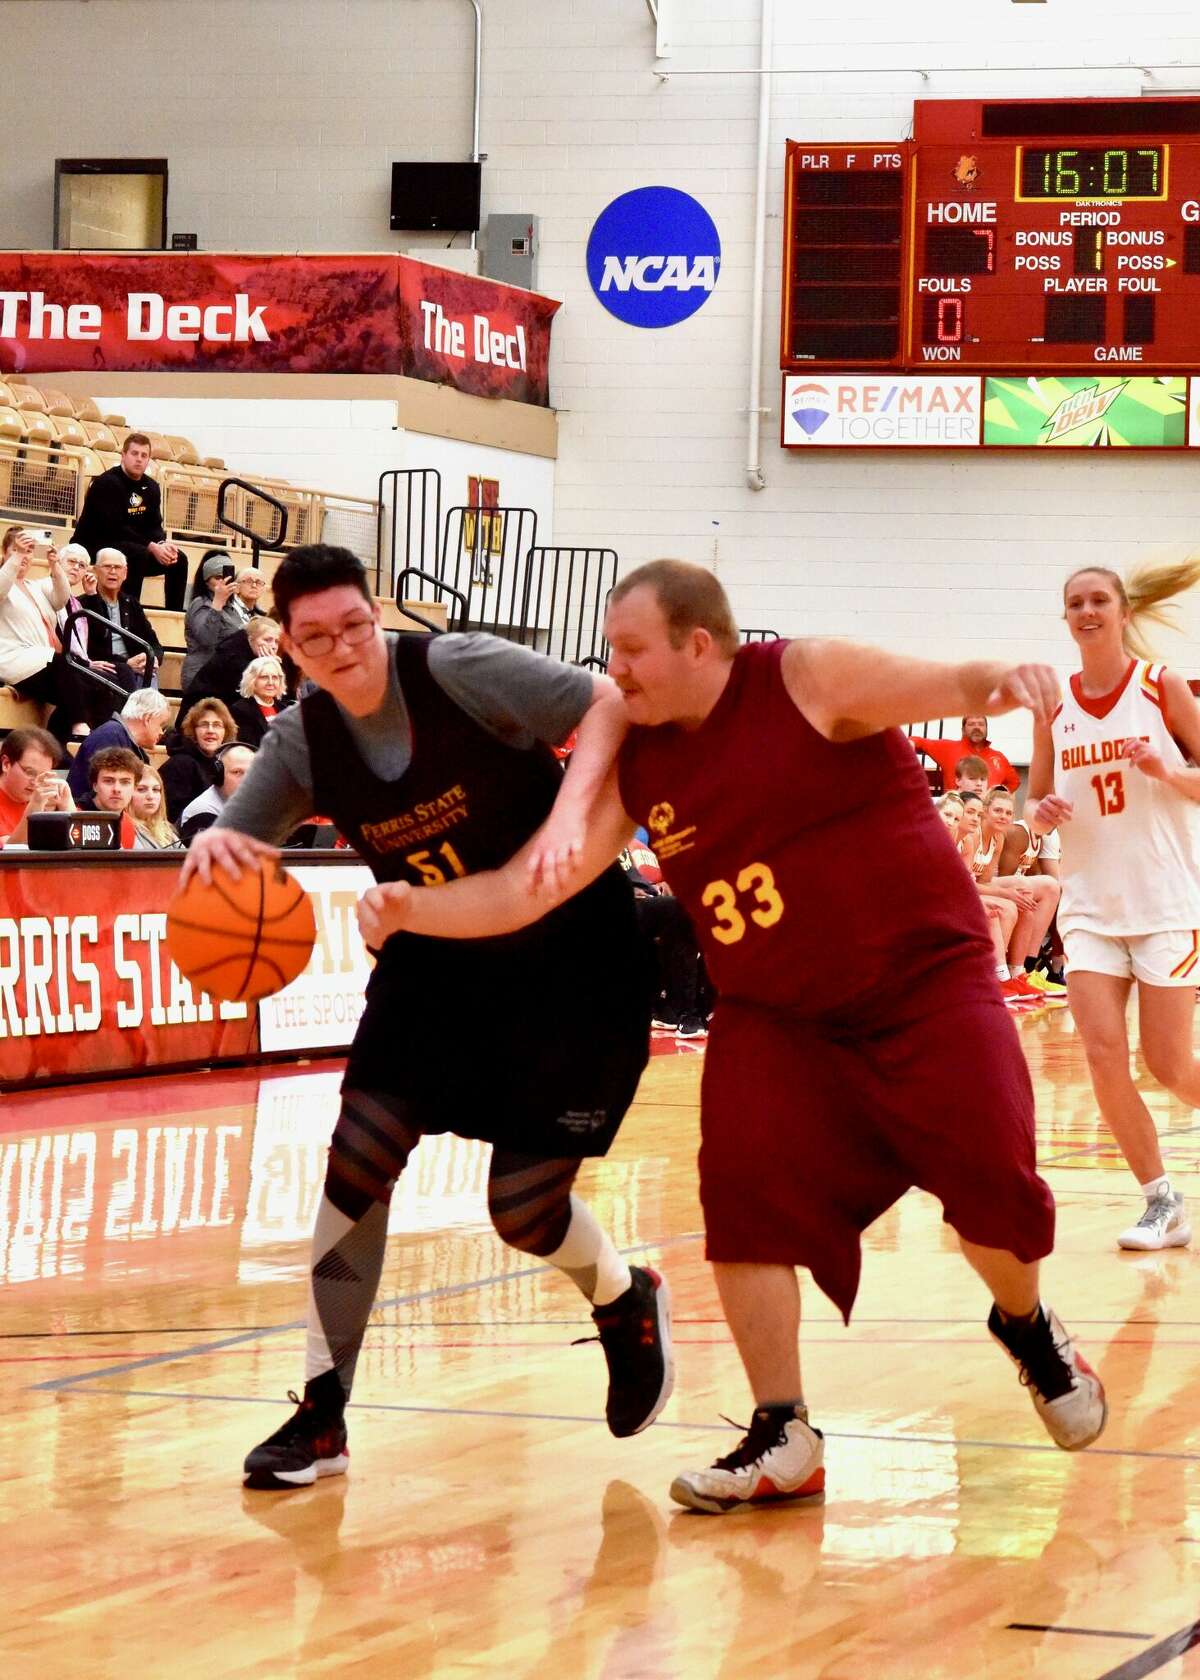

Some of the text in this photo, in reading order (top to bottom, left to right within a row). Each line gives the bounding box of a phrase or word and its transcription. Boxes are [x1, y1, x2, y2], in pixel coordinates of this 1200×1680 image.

[801, 153, 902, 169] PLR F PTS
[1044, 150, 1159, 194] 16:07
[927, 202, 997, 223] HOME
[1059, 211, 1121, 226] PERIOD
[972, 229, 994, 271] 7
[1015, 231, 1073, 246] BONUS
[1106, 231, 1165, 246] BONUS
[600, 255, 716, 291] NCAA
[1014, 255, 1061, 270] POSS
[1117, 255, 1164, 270] POSS
[918, 277, 972, 292] FOULS
[1043, 277, 1162, 292] PLAYER FOUL
[0, 291, 272, 342] The Deck
[420, 300, 466, 359] The
[937, 298, 962, 342] 0
[922, 346, 962, 361] WON
[1093, 346, 1143, 361] GAME
[836, 385, 975, 414] RE/MAX
[836, 416, 976, 441] TOGETHER
[1061, 735, 1150, 771] BULLDO
[1091, 770, 1126, 817] 13
[360, 783, 468, 841] FERRIS STATE
[371, 803, 470, 854] UNIVERSITY
[405, 840, 467, 887] 51
[701, 862, 785, 945] 33
[113, 913, 248, 1028] STA
[271, 996, 309, 1030] THE
